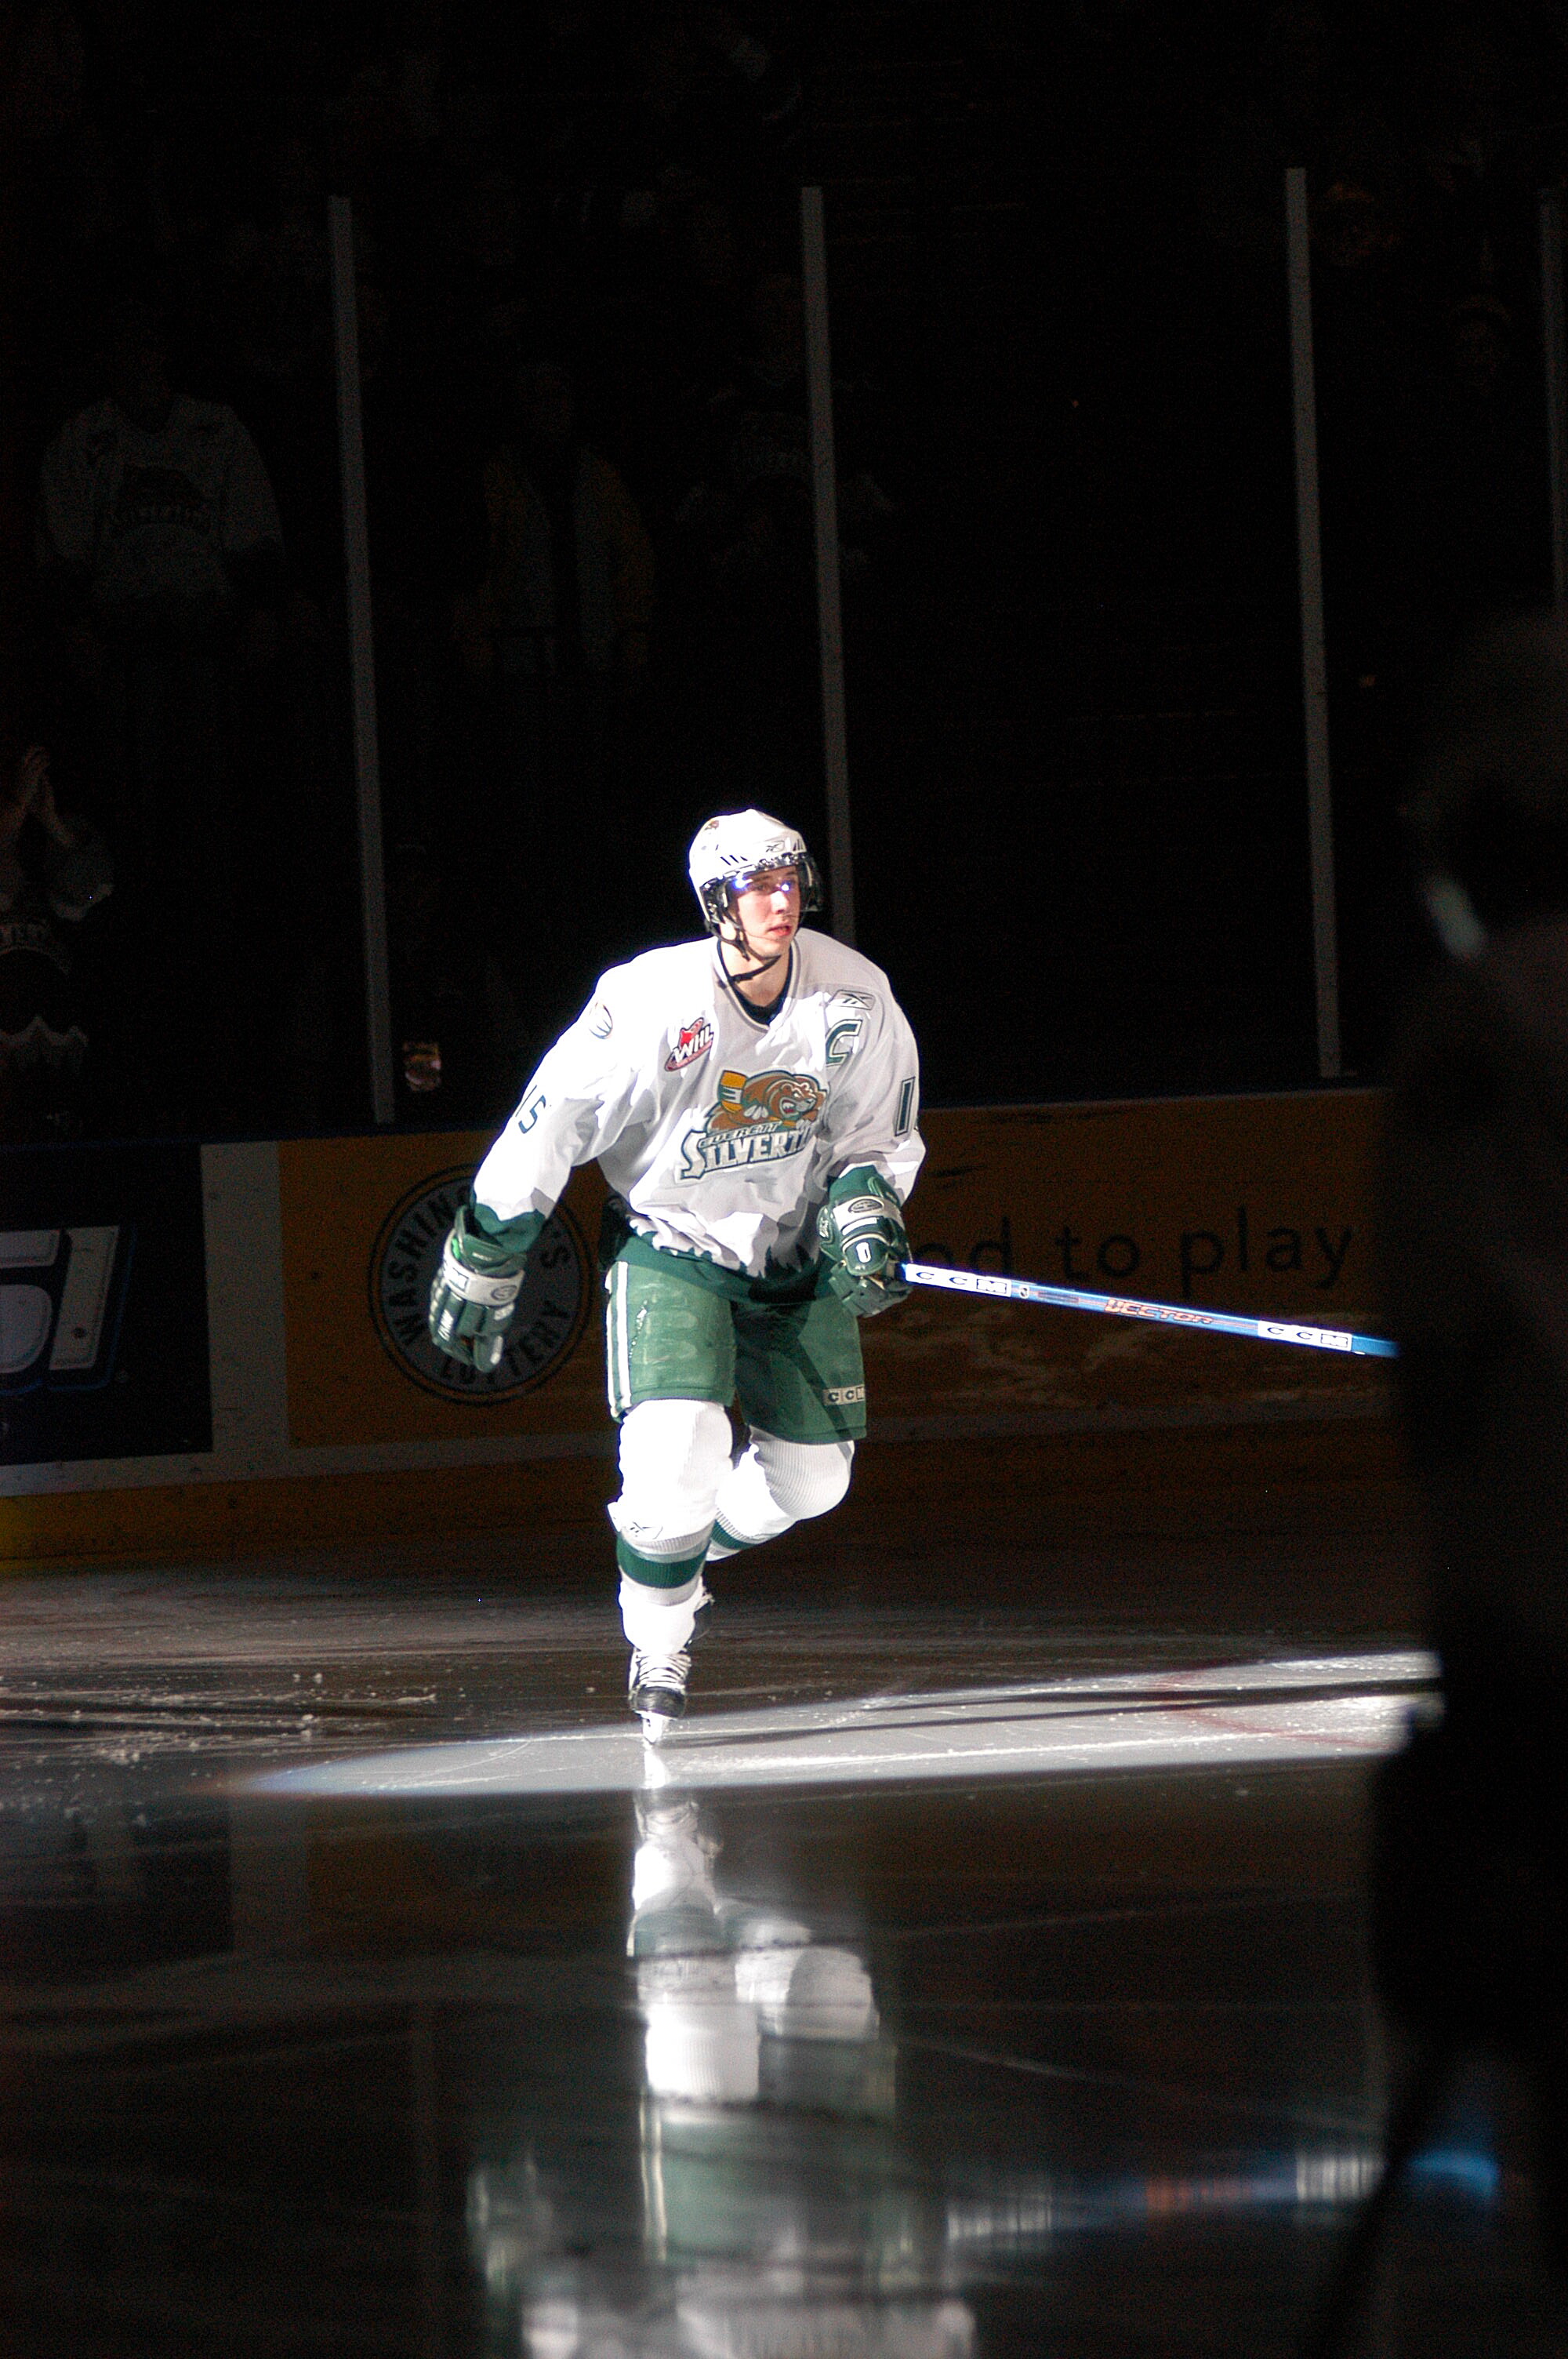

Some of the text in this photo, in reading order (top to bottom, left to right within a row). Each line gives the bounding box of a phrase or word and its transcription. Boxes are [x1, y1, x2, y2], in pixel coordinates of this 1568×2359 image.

[672, 1022, 714, 1063] WHL
[826, 1019, 863, 1067] C
[681, 1129, 813, 1180] SILVERTI
[1056, 1226, 1142, 1280] to
[1180, 1206, 1352, 1299] play
[916, 1270, 1008, 1294] CCM
[1104, 1296, 1214, 1325] VECTOR
[440, 1299, 572, 1385] LOTERY
[1267, 1326, 1349, 1348] CCM
